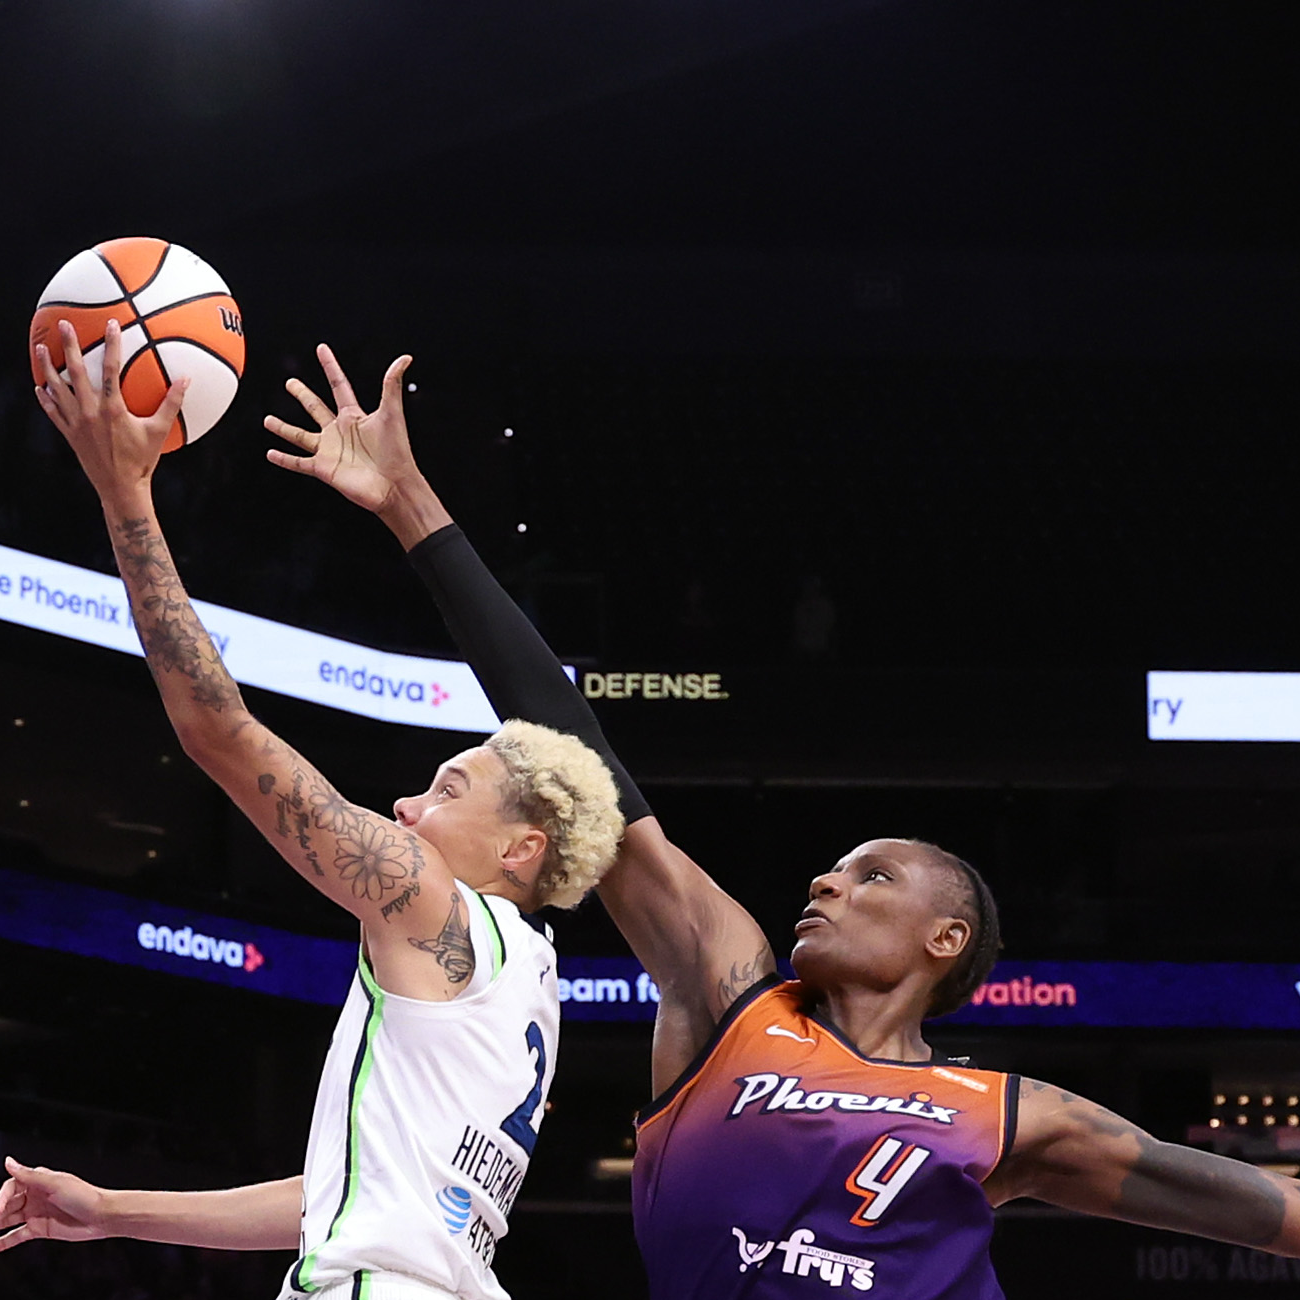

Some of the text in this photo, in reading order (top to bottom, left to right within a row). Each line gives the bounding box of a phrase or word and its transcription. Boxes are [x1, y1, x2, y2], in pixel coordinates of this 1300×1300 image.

[20, 576, 121, 626] Phoenix
[319, 656, 425, 704] endava
[138, 920, 245, 970] endava
[558, 978, 630, 1003] eam
[725, 1072, 961, 1126] Phoenix
[845, 1133, 931, 1227] 4
[776, 1228, 875, 1291] fry's
